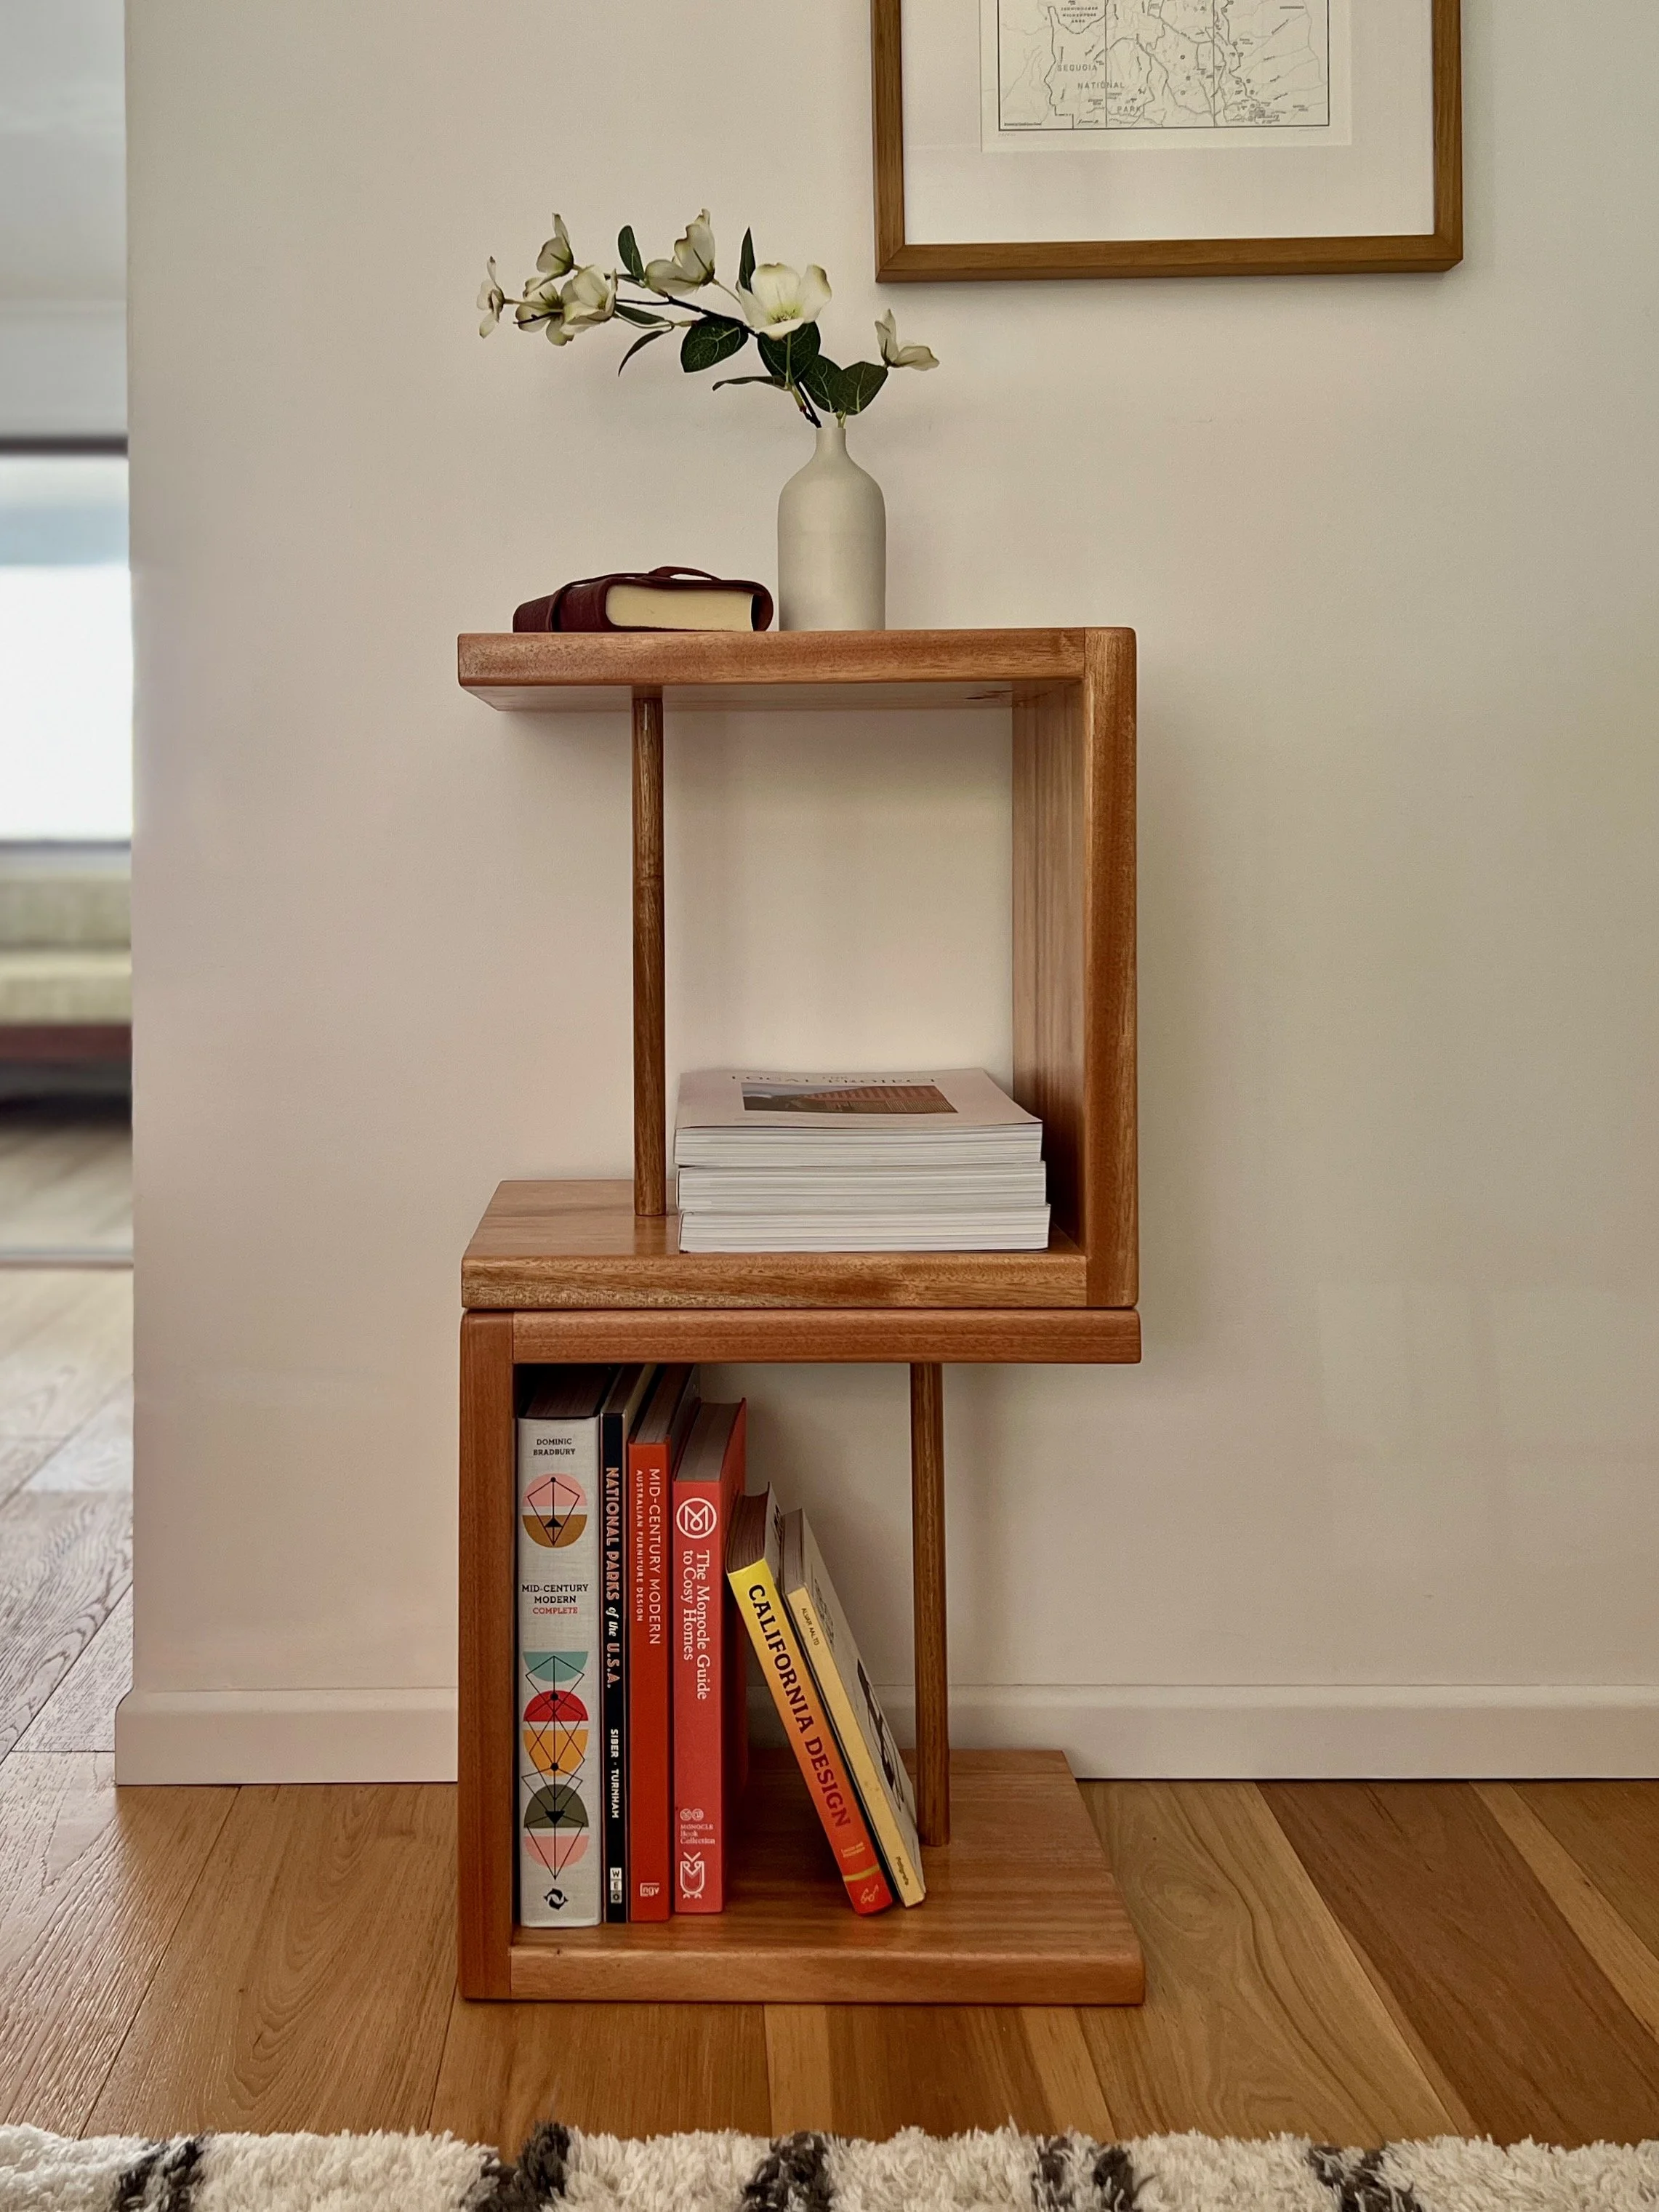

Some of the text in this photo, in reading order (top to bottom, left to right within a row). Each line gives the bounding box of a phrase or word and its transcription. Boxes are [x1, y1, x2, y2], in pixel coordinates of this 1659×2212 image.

[522, 1584, 589, 1593] MID-CENTURY
[534, 1595, 577, 1604] MODERN
[606, 1467, 620, 1688] NATIONAL PARKS of the U.S.A.
[649, 1468, 660, 1644] MID-CENTURY MODERN
[680, 1551, 696, 1661] to Cosy Homes
[696, 1550, 710, 1700] The Monocle Guide
[801, 1607, 820, 1646] ALVAR AALTO
[748, 1584, 851, 1828] CALIFORNIA DESIGN
[610, 1729, 619, 1819] SIBER TURNHAM
